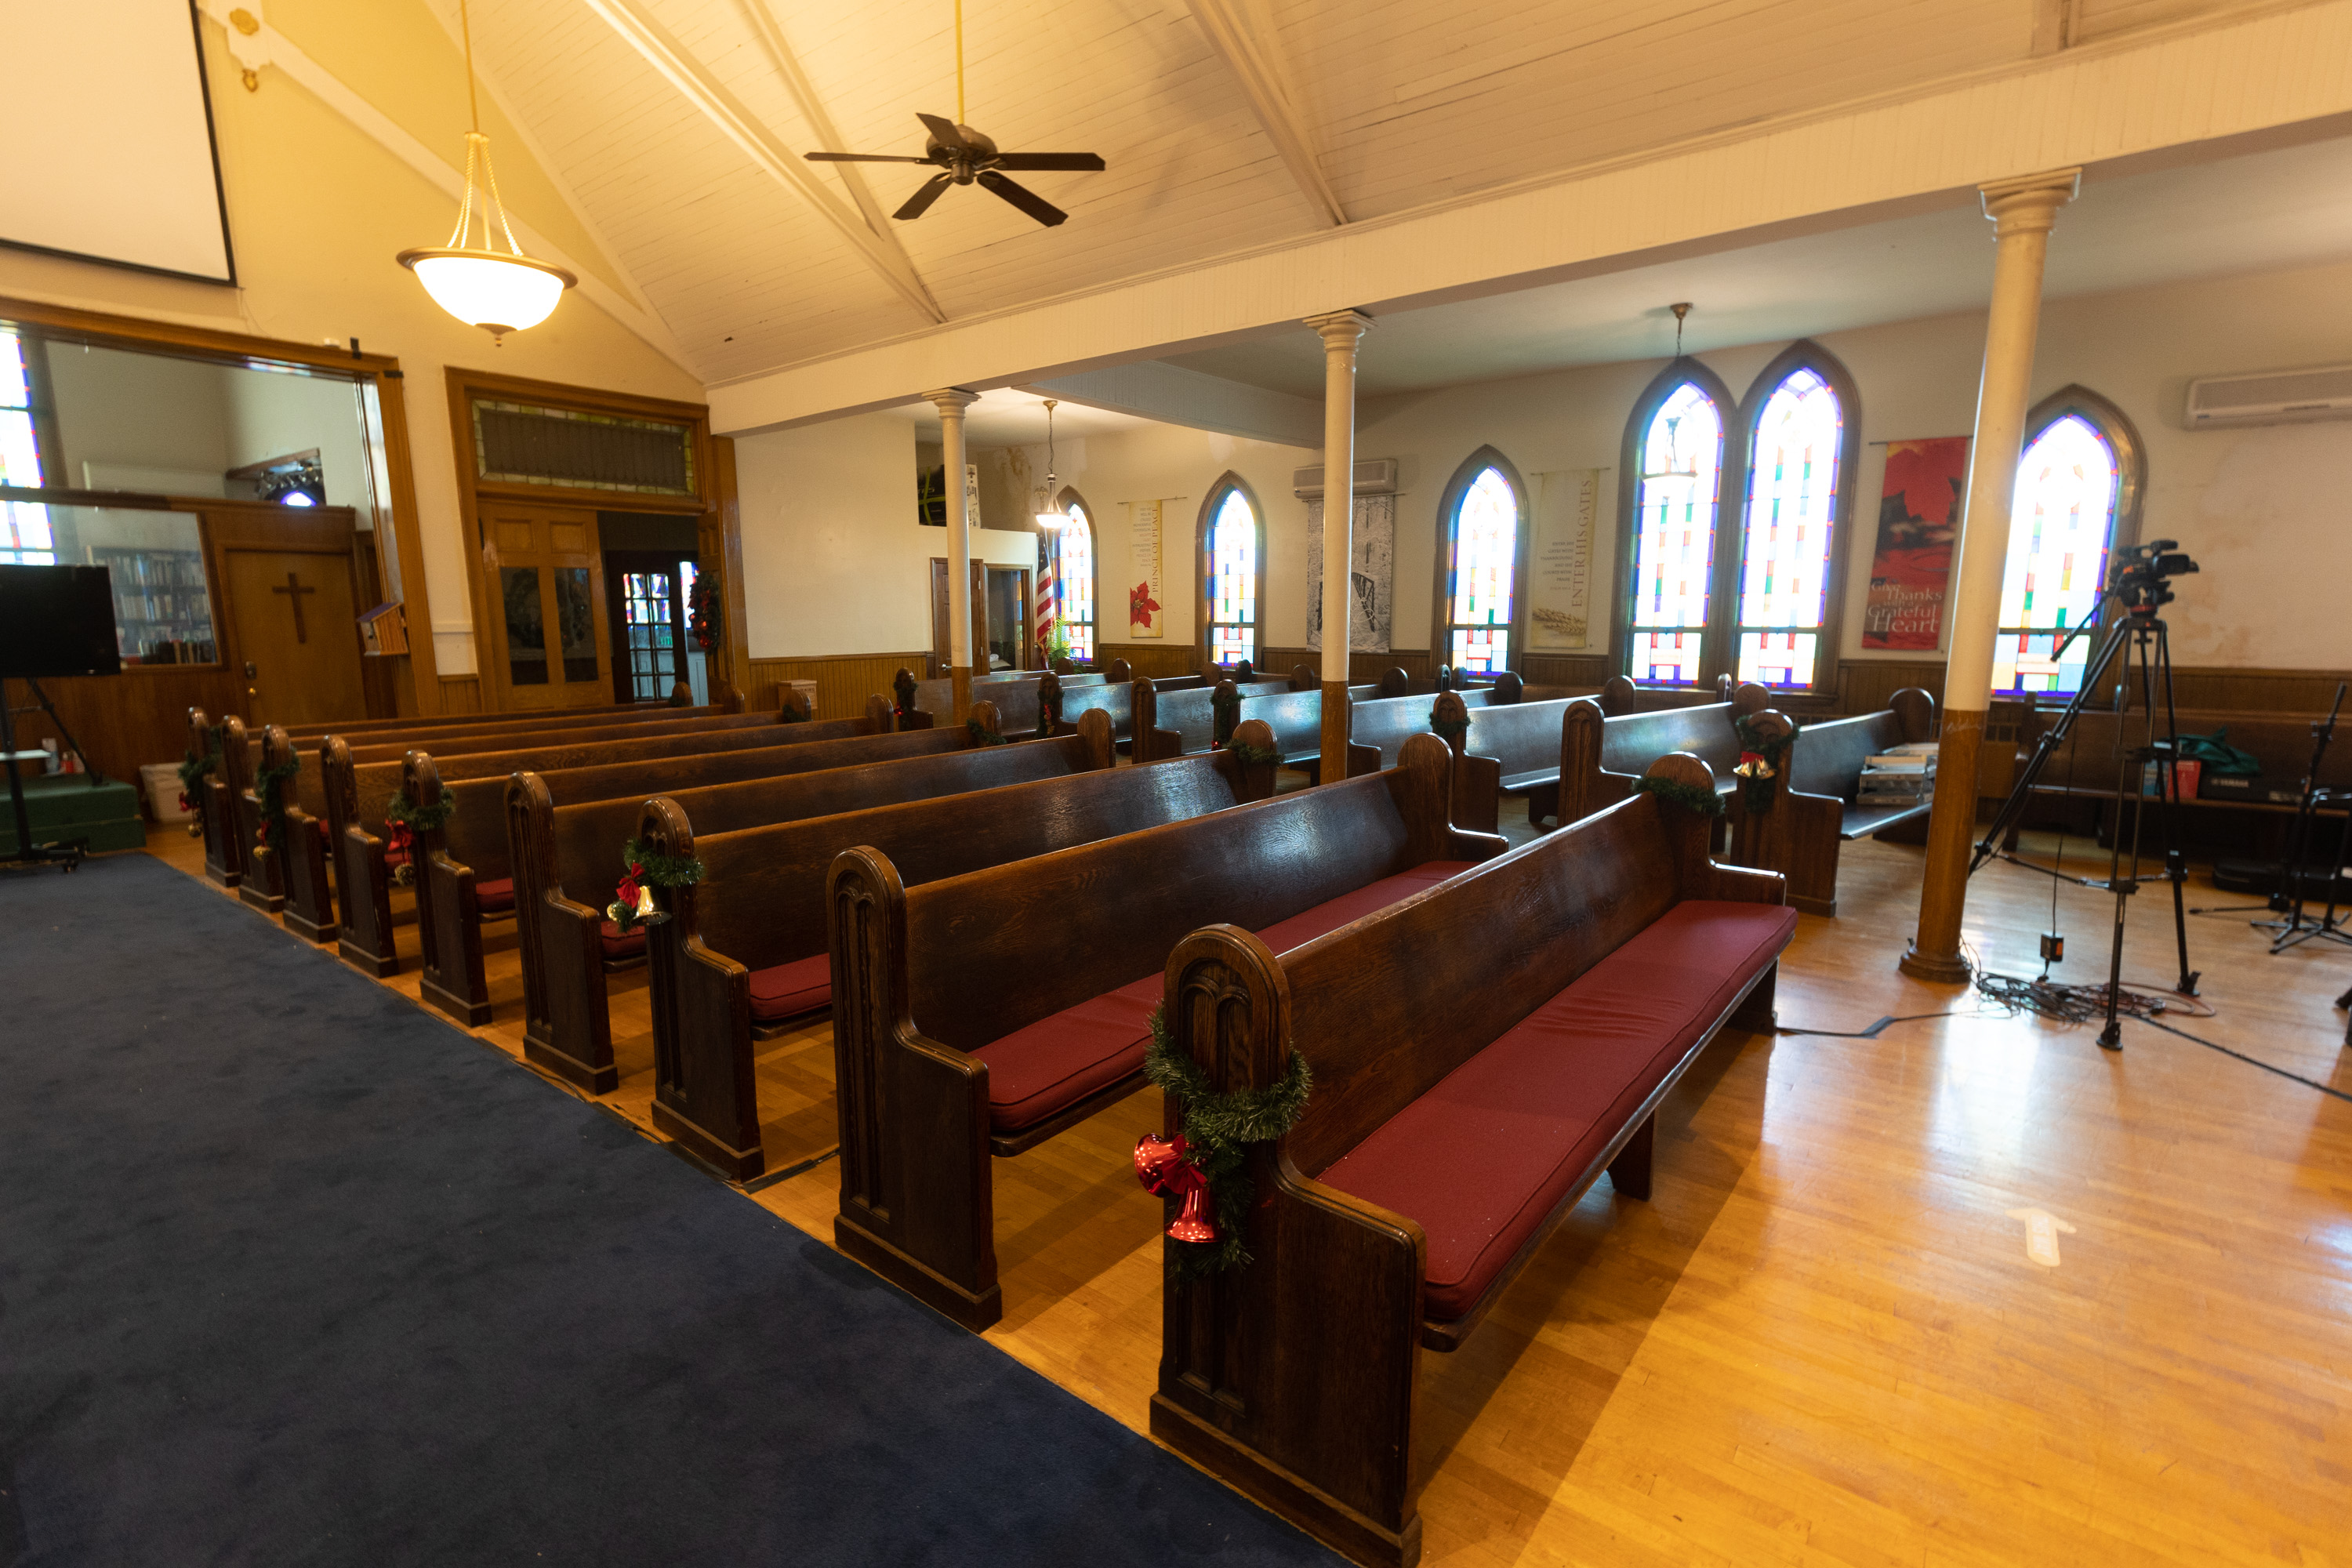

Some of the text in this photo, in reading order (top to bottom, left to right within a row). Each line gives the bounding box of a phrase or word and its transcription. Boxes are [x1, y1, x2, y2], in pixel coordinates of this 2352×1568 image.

[1152, 540, 1158, 554] OF
[1572, 481, 1591, 607] ENTER HIS GATES
[1871, 583, 1900, 591] Give
[1886, 587, 1942, 601] Thanks
[1867, 603, 1936, 618] Grateful
[1872, 612, 1939, 633] Heart
